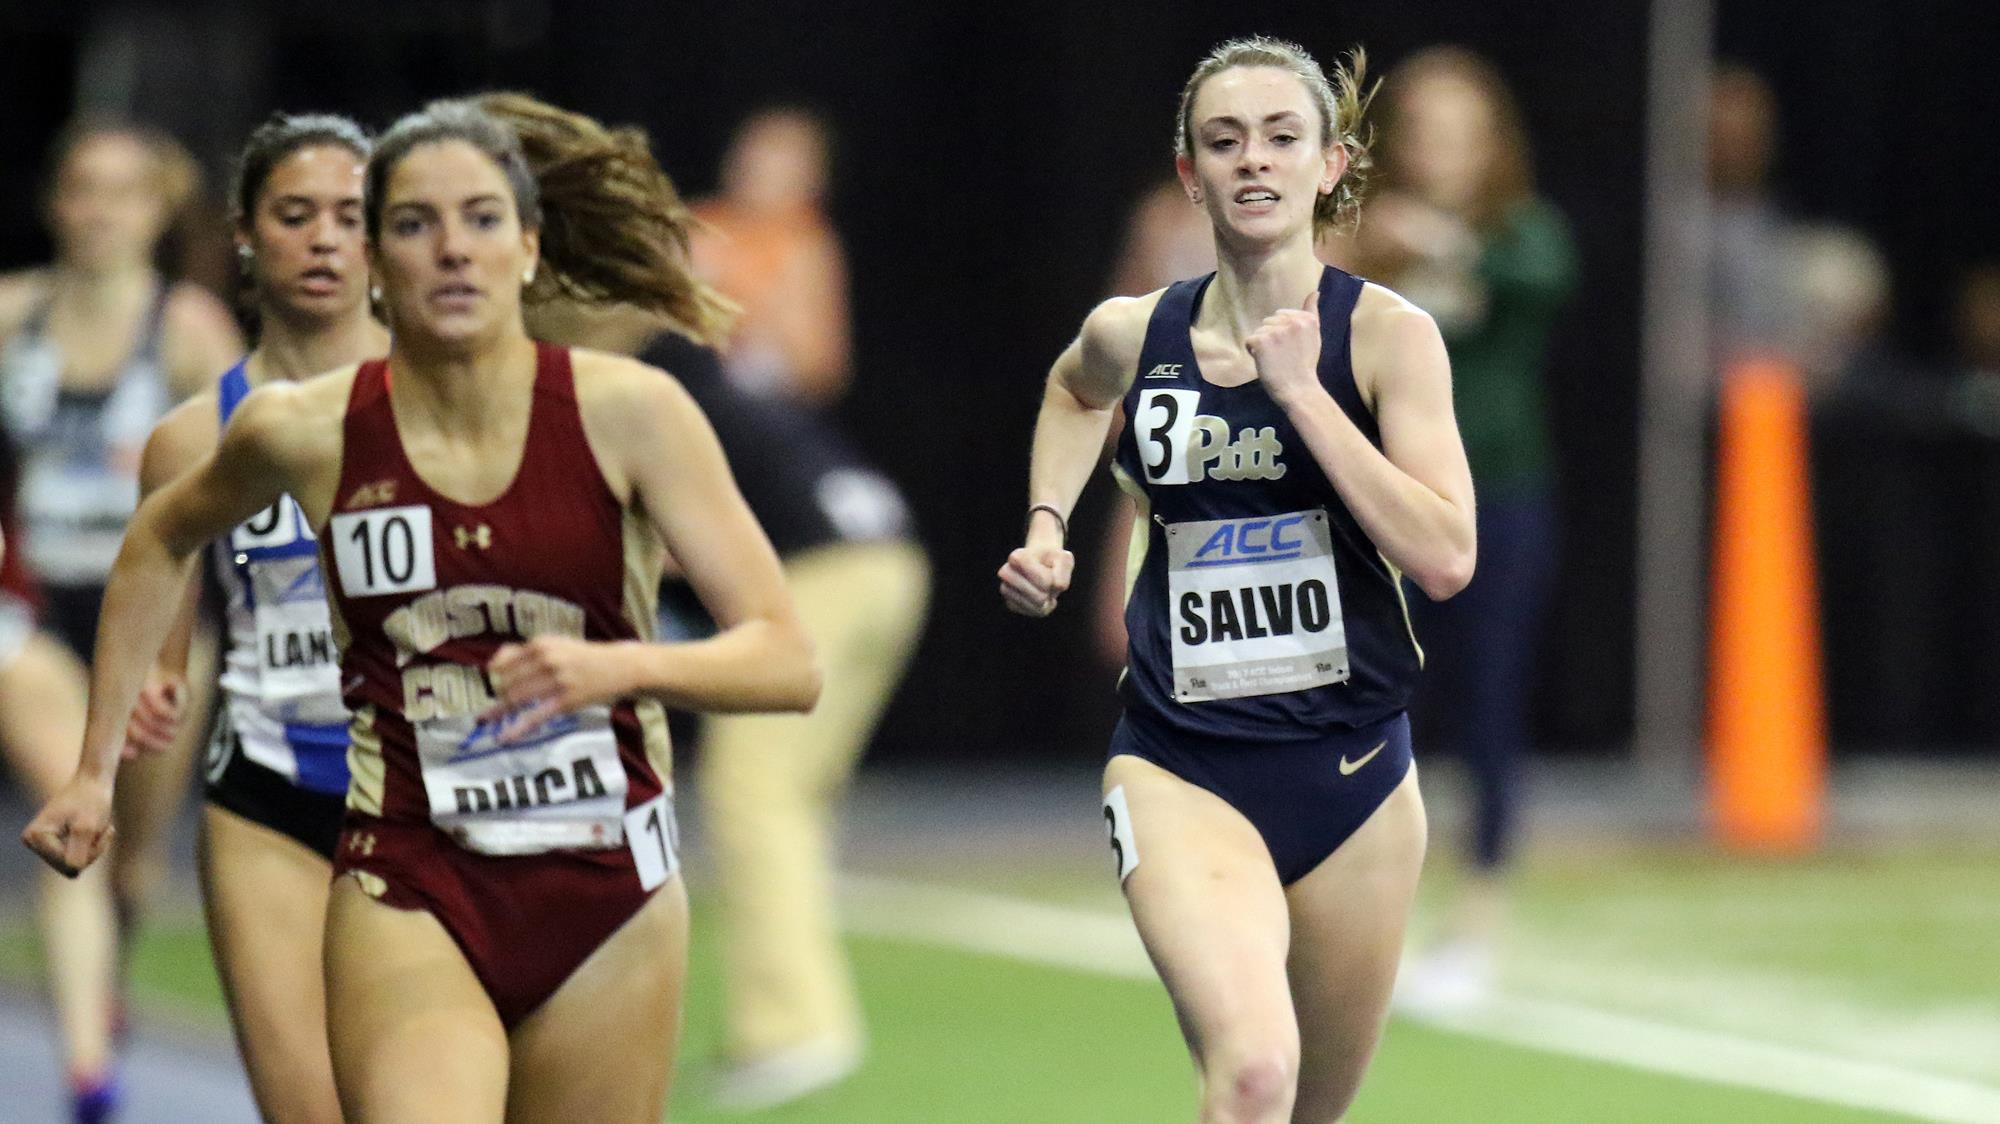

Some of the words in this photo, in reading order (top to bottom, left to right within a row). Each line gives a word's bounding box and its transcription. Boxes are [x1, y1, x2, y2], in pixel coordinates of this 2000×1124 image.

[1147, 363, 1184, 377] ACC
[1146, 393, 1179, 480] 3
[1186, 415, 1287, 482] Pitt
[352, 516, 414, 588] 10
[1194, 515, 1307, 559] ACC
[1179, 579, 1330, 646] SALVO
[266, 629, 333, 668] LAN
